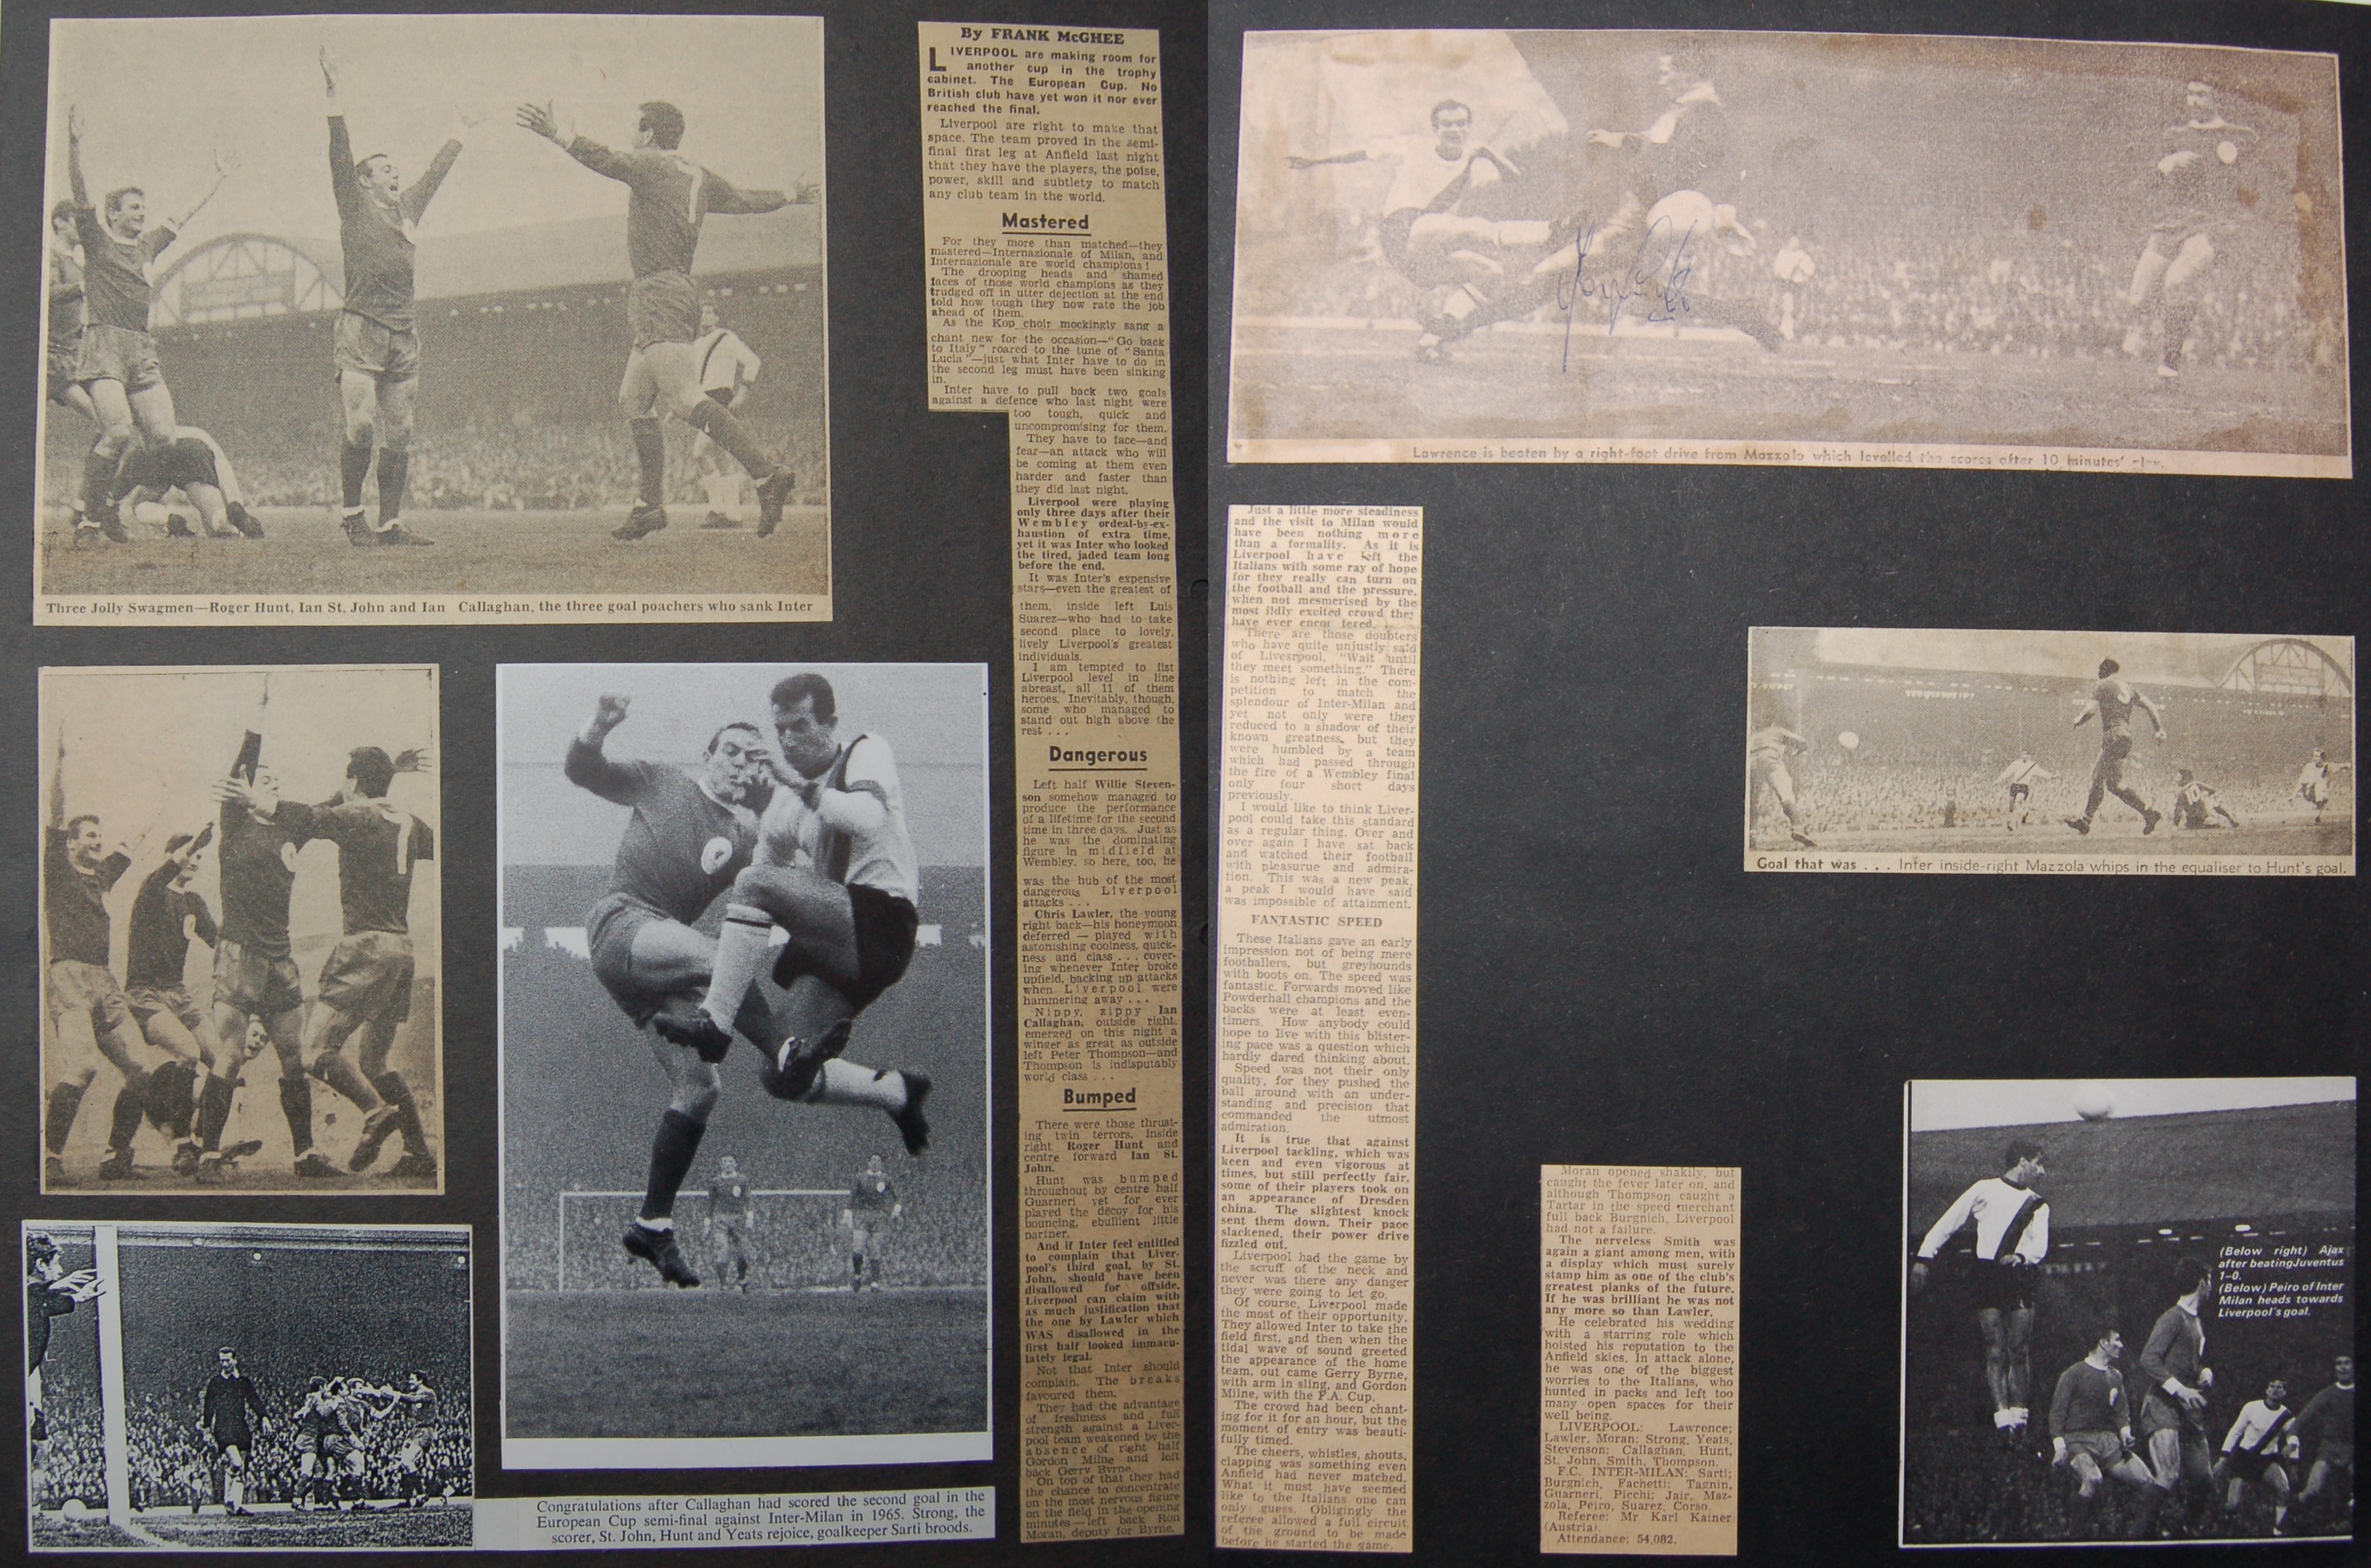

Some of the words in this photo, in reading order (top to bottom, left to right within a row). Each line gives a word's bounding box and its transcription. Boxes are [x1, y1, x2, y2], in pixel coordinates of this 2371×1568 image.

[960, 26, 983, 42] By
[990, 27, 1050, 42] FRANK
[1057, 30, 1125, 45] McGHEE
[1024, 50, 1044, 60] are
[1050, 50, 1096, 63] making
[1102, 54, 1133, 63] room
[1138, 53, 1157, 64] for
[966, 61, 1015, 72] another
[1026, 64, 1049, 75] cup
[1061, 63, 1073, 75] in
[1084, 65, 1105, 76] the
[1116, 67, 1157, 80] trophy
[926, 73, 976, 85] cabinet.
[989, 75, 1014, 86] The
[1028, 76, 1085, 90] European
[1100, 79, 1127, 92] Cup.
[1140, 81, 1157, 92] No
[927, 87, 970, 99] British
[975, 88, 1001, 100] club
[1005, 89, 1035, 101] have
[1040, 92, 1058, 104] yet
[1063, 94, 1088, 103] won
[1093, 93, 1102, 104] it
[1107, 95, 1127, 104] nor
[1132, 96, 1157, 106] ever
[926, 102, 976, 113] reached
[982, 103, 1002, 114] the
[1009, 104, 1040, 115] final.
[1002, 211, 1089, 230] Mastered
[1018, 559, 1053, 571] before
[1057, 560, 1076, 571] the
[1081, 561, 1105, 571] end.
[46, 602, 87, 614] Three
[90, 602, 123, 616] Jolly
[254, 602, 294, 614] Hunt,
[299, 602, 322, 613] Ian
[327, 601, 346, 614] St.
[349, 602, 385, 613] John
[390, 601, 416, 613] and
[421, 601, 445, 613] Ian
[458, 600, 535, 615] Callaghan,
[538, 600, 561, 612] the
[566, 599, 603, 611] three
[607, 599, 637, 614] goal
[641, 599, 704, 614] poachers
[707, 600, 736, 611] who
[740, 600, 773, 612] sank
[777, 600, 813, 611] Inter
[1049, 745, 1147, 766] Dangerous
[1756, 856, 1788, 869] Goal
[1794, 857, 1824, 870] that
[1830, 861, 1857, 870] was
[1899, 857, 1932, 871] Inter
[1939, 859, 2019, 873] inside-right
[2025, 859, 2084, 873] Mazzola
[2089, 859, 2130, 875] whips
[2135, 861, 2148, 873] in
[2153, 861, 2177, 873] the
[2181, 861, 2242, 875] equaliser
[2247, 861, 2261, 873] to
[2315, 861, 2347, 876] goal.
[1250, 914, 1329, 926] FANTASTIC
[1337, 916, 1383, 928] SPEED
[1236, 932, 1272, 945] These
[1277, 933, 1323, 945] Italians
[1327, 937, 1356, 947] gave
[1360, 938, 1376, 947] an
[1380, 936, 1412, 950] early
[1063, 1086, 1136, 1109] Bumped
[1558, 1233, 1582, 1245] The
[1595, 1235, 1651, 1245] nerveless
[1664, 1236, 1700, 1247] Smith
[1713, 1238, 1736, 1247] was
[1545, 1246, 1578, 1257] again
[1582, 1249, 1590, 1257] a
[1594, 1246, 1625, 1258] giant
[1629, 1249, 1671, 1259] among
[1674, 1250, 1704, 1260] men,
[1707, 1247, 1736, 1259] with
[2219, 1245, 2263, 1258] (Below
[2273, 1245, 2308, 1257] right)
[2318, 1244, 2344, 1257] Ajax
[2217, 1258, 2248, 1269] after
[2218, 1282, 2267, 1295] (Below)
[2268, 1281, 2300, 1293] Peiro
[2301, 1281, 2315, 1292] of
[2315, 1281, 2344, 1291] Inter
[2218, 1295, 2253, 1305] Milan
[2256, 1294, 2291, 1305] heads
[2296, 1293, 2344, 1304] towards
[2282, 1305, 2310, 1319] goal.
[1558, 1420, 1643, 1432] LIVERPOOL:
[1669, 1421, 1732, 1435] Lawrence;
[536, 1498, 642, 1515] Congratulations
[647, 1498, 679, 1511] after
[685, 1497, 751, 1514] Callaghan
[757, 1496, 781, 1510] had
[788, 1495, 830, 1508] scored
[836, 1494, 857, 1507] the
[863, 1492, 907, 1506] second
[912, 1491, 940, 1507] goal
[946, 1490, 959, 1503] in
[965, 1489, 985, 1502] the
[536, 1515, 601, 1531] European
[608, 1514, 637, 1530] Cup
[643, 1513, 707, 1526] semi-final
[714, 1512, 761, 1529] against
[768, 1510, 844, 1524] Inter-Milan
[851, 1509, 864, 1522] in
[872, 1507, 904, 1522] 1965.
[911, 1507, 958, 1522] Strong,
[964, 1505, 985, 1518] the
[551, 1533, 595, 1544] scorer,
[599, 1529, 616, 1543] St.
[619, 1529, 656, 1543] John,
[659, 1529, 694, 1542] Hunt
[697, 1528, 721, 1541] and
[725, 1527, 763, 1541] Yeats
[766, 1526, 814, 1543] rejoice,
[816, 1524, 888, 1541] goalkeeper
[890, 1522, 921, 1536] Sarti
[924, 1520, 972, 1534] broods.
[1556, 1532, 1629, 1544] Attendance:
[1636, 1533, 1677, 1545] 54,082.
